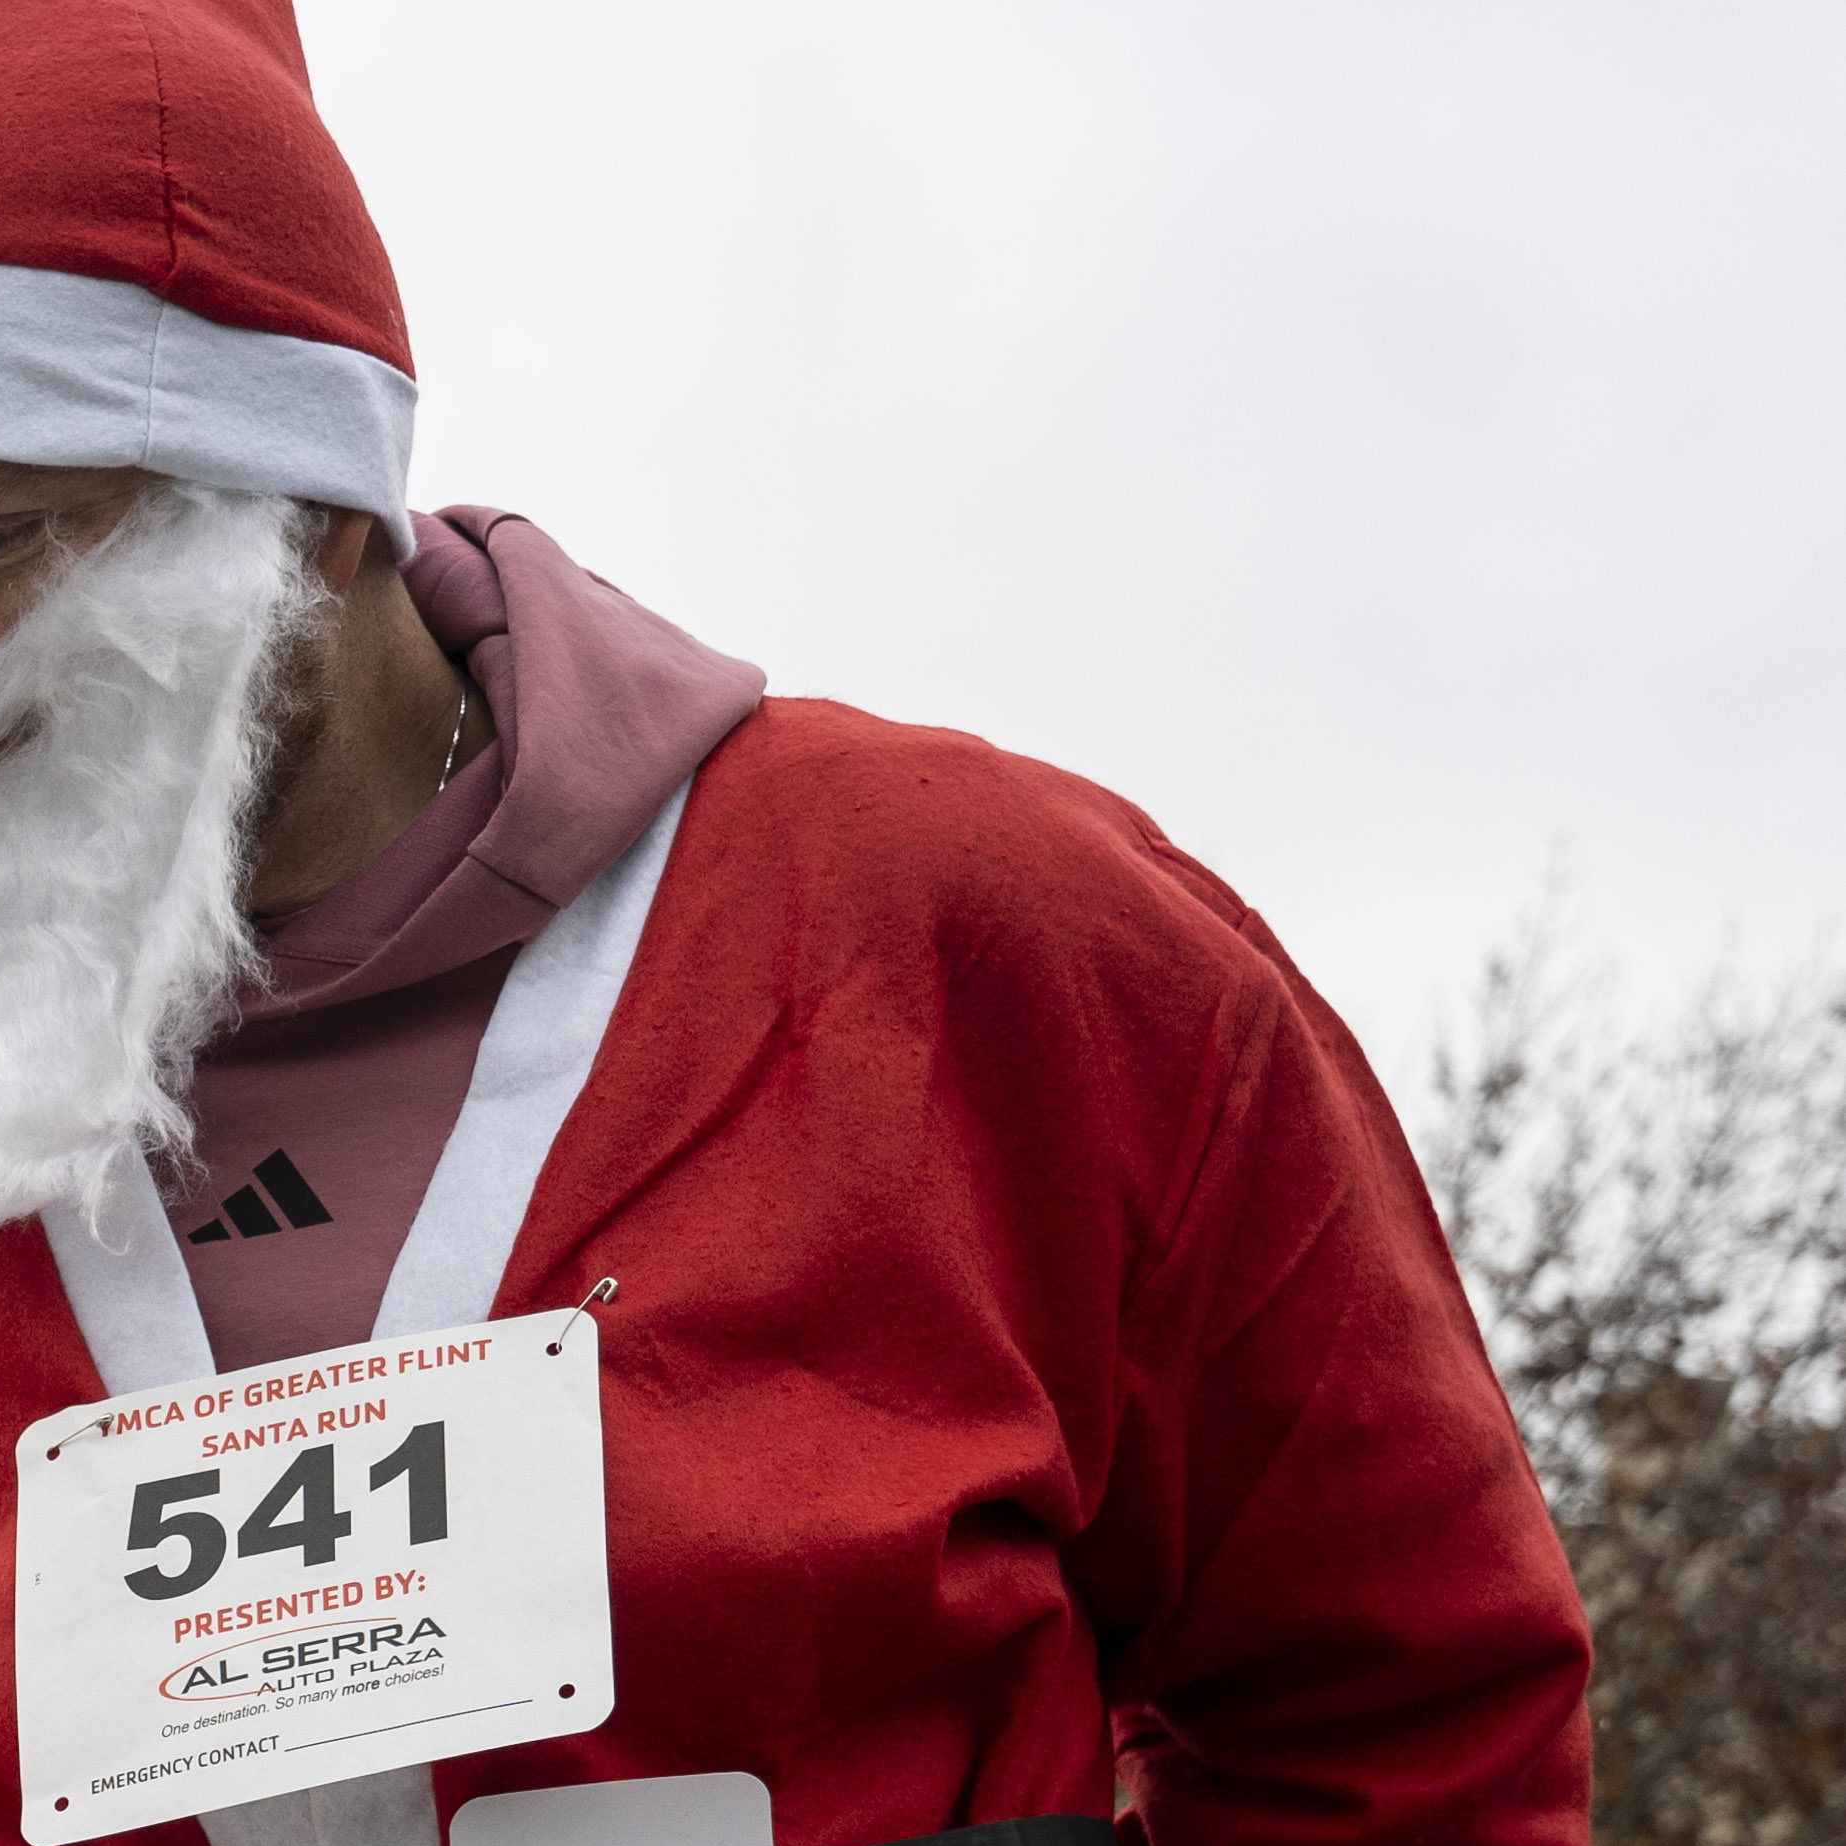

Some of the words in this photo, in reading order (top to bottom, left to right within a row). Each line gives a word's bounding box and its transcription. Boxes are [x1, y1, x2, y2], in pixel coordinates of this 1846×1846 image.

[194, 1390, 233, 1418] OF
[244, 1357, 388, 1408] GREATER
[399, 1339, 492, 1374] FLINT
[202, 1422, 308, 1458] SANTA
[318, 1400, 387, 1436] RUN
[124, 1420, 448, 1601] 541
[174, 1581, 363, 1644] PRESENTED
[375, 1570, 426, 1600] BY:
[181, 1660, 248, 1695] AL
[261, 1617, 447, 1674] SERRA
[257, 1668, 335, 1697] AUTO
[350, 1647, 444, 1677] PLAZA
[161, 1722, 189, 1738] One
[193, 1703, 271, 1734] destination.
[275, 1694, 294, 1709] So
[297, 1687, 339, 1706] many
[342, 1678, 380, 1696] more
[384, 1664, 445, 1687] choices!
[91, 1756, 193, 1795] EMERGENCY
[198, 1735, 280, 1768] CONTACT
